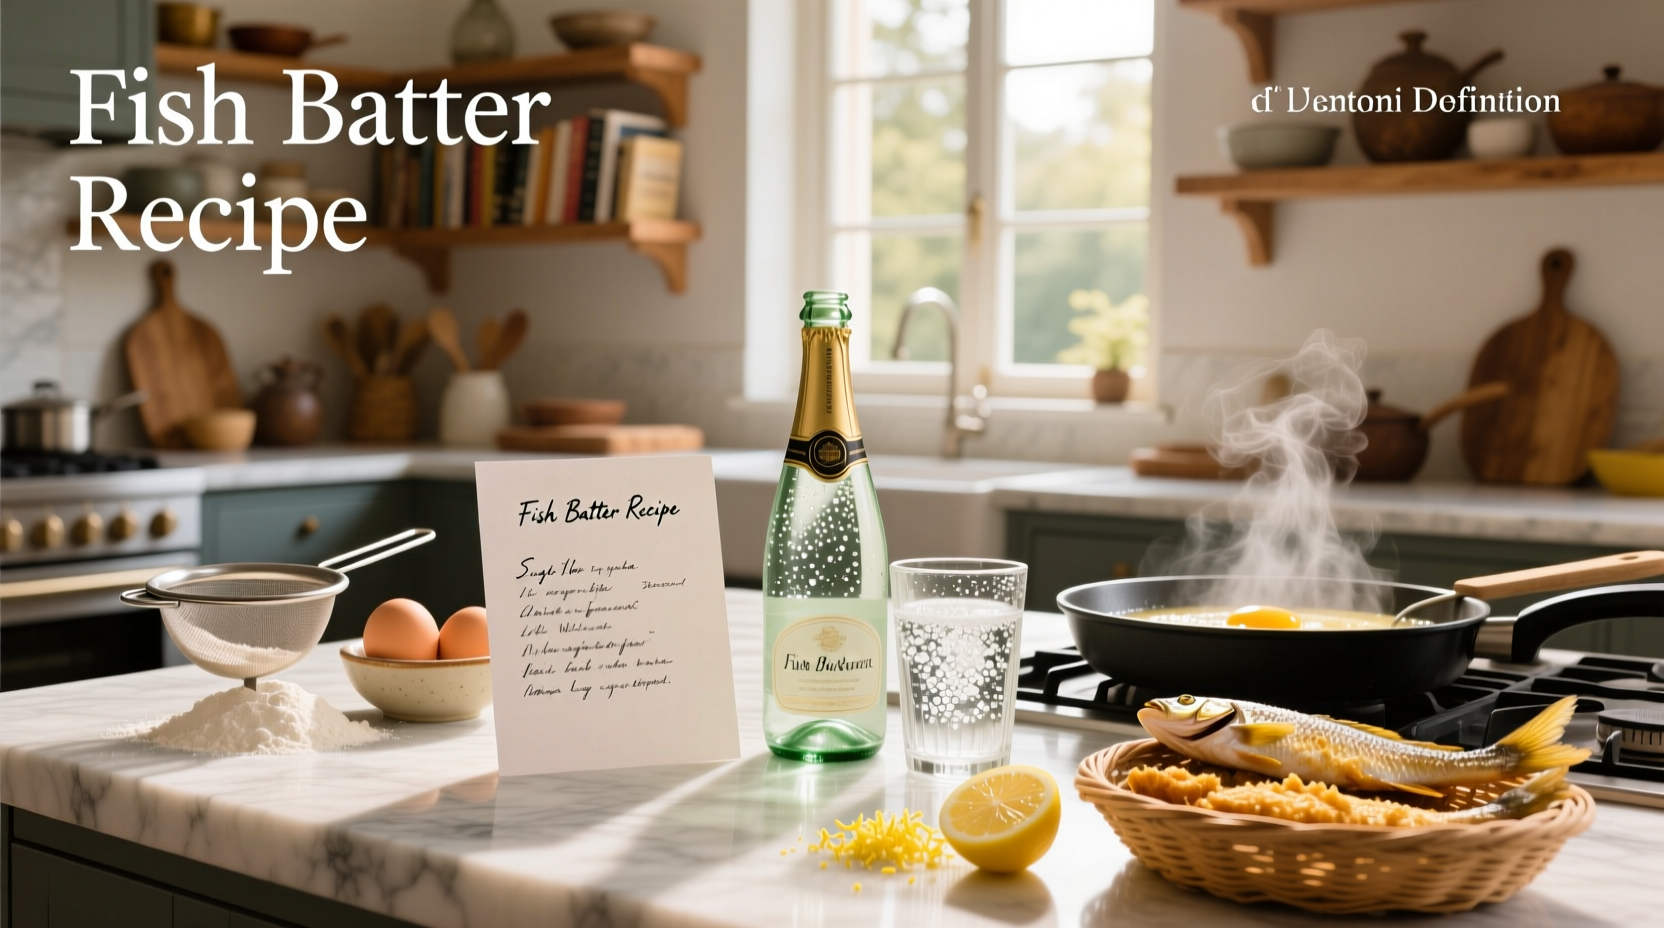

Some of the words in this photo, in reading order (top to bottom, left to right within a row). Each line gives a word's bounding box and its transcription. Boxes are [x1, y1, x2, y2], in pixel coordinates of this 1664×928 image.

[518, 499, 558, 527] Fish
[564, 498, 620, 523] Batter
[625, 494, 681, 527] Recipe
